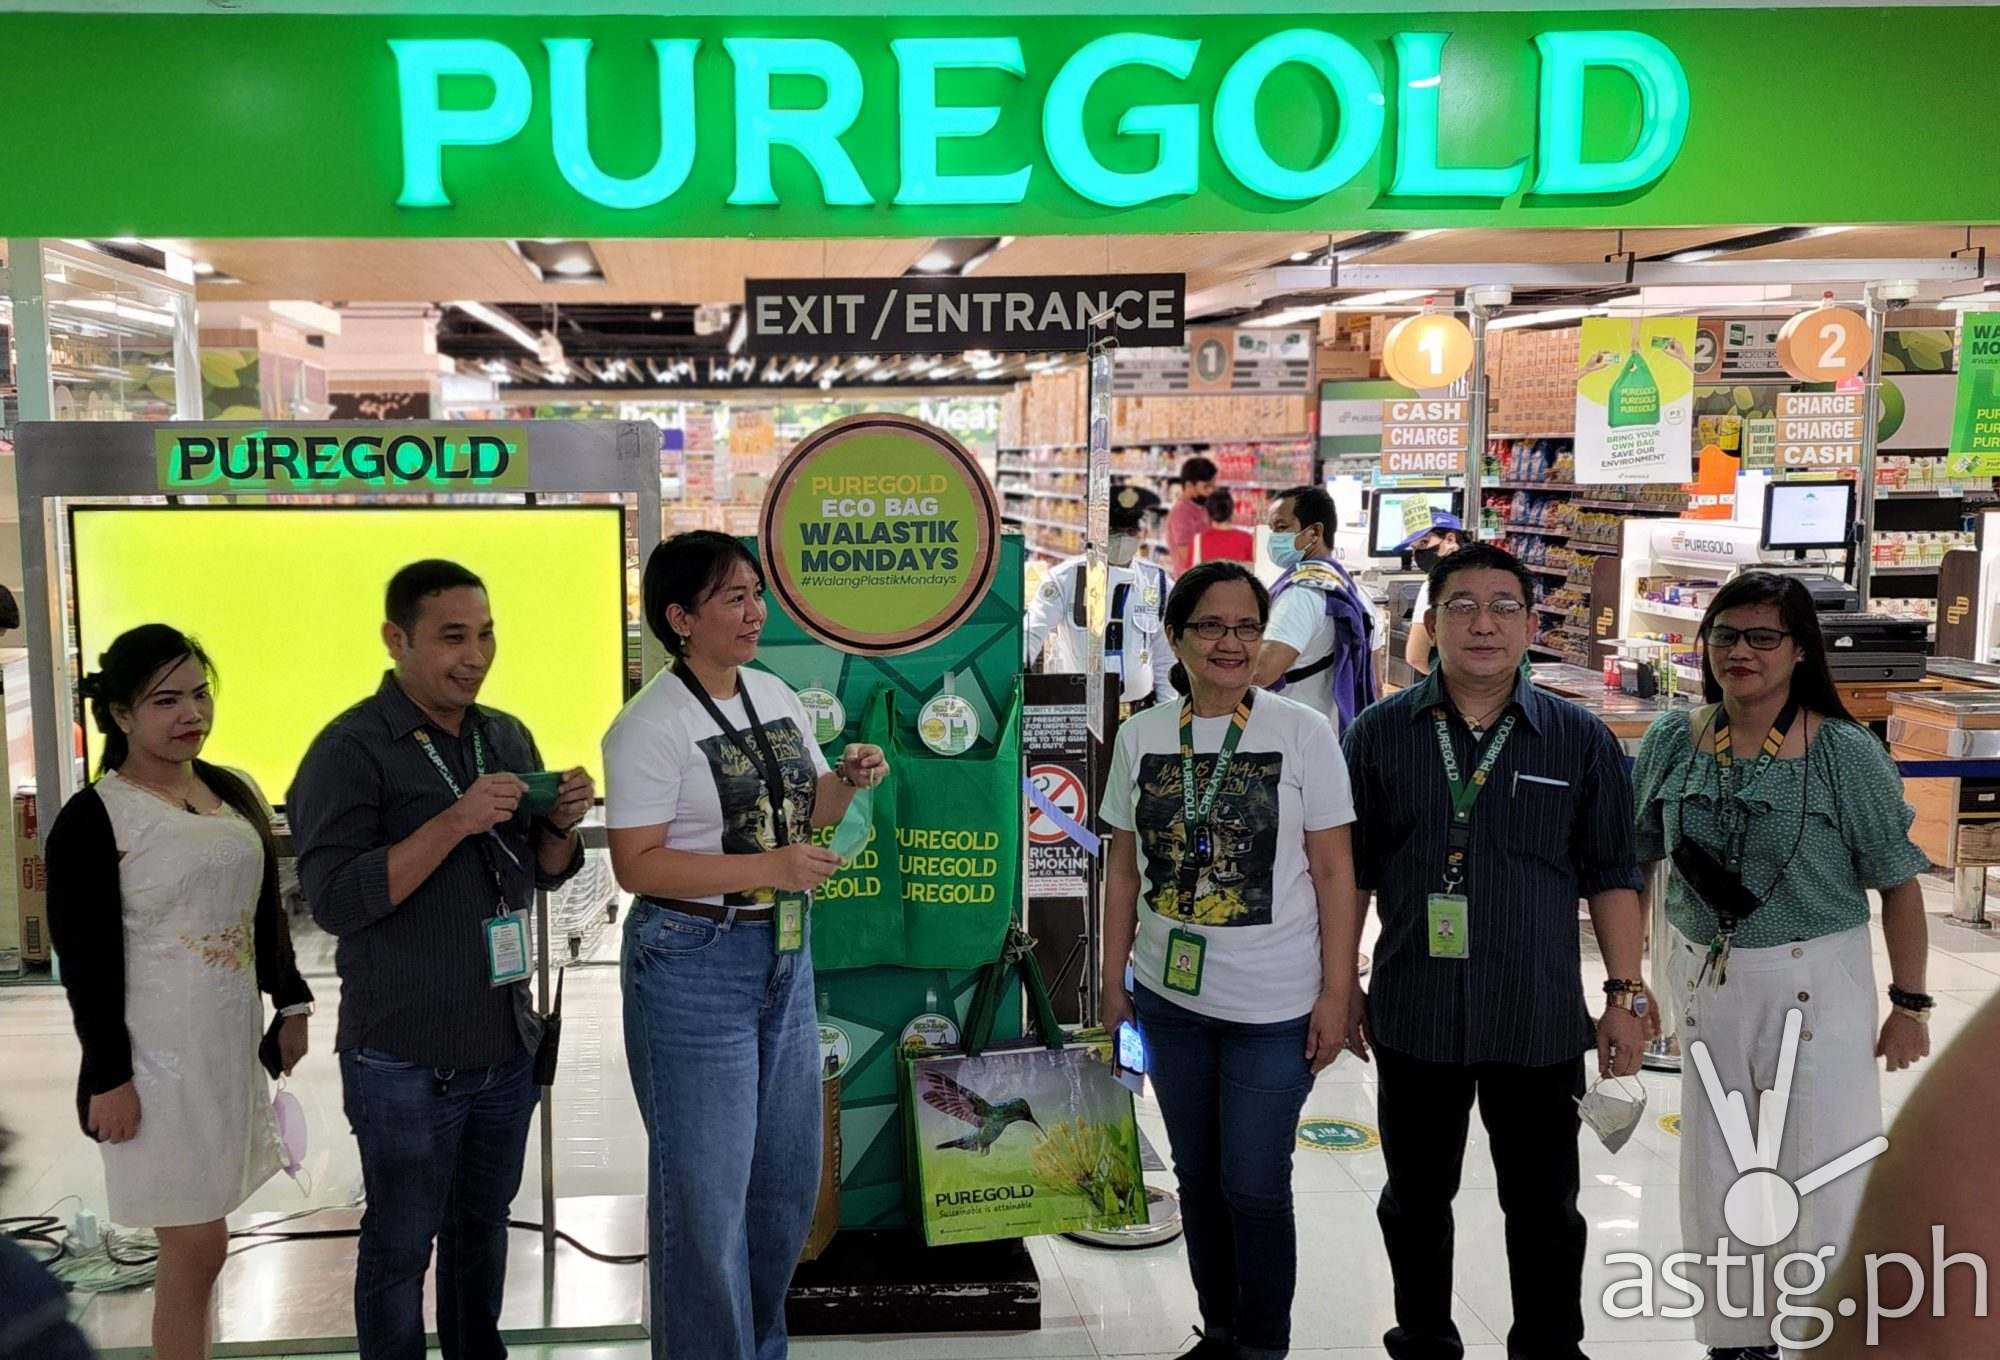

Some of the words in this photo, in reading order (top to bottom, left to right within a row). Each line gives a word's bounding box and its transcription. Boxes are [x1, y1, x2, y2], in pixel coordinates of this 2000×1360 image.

[387, 29, 1691, 209] PUREGOLD
[755, 295, 865, 335] EXIT
[905, 289, 1176, 334] ENTRANCE
[1417, 328, 1444, 375] 1
[1818, 323, 1847, 368] 2
[1203, 347, 1218, 373] 1
[920, 402, 997, 429] Meat
[1391, 402, 1461, 421] CASH
[1786, 396, 1855, 415] CHARGE
[1391, 427, 1459, 446] CHARGE
[1606, 435, 1634, 443] BRING
[1637, 430, 1660, 438] YOUR
[1786, 421, 1855, 440] CHARGE
[1611, 450, 1634, 459] SAVE
[1636, 447, 1655, 455] OUR
[1636, 439, 1655, 447] BAG
[177, 435, 509, 481] PUREGOLD
[1389, 452, 1458, 471] CHARGE
[1601, 454, 1665, 467] ENVIRONMENT
[1784, 446, 1853, 464] CASH
[811, 475, 948, 496] PUREGOLD
[822, 500, 875, 518] ECO
[885, 498, 939, 516] BAG
[799, 520, 960, 545] WALASTIK
[1684, 538, 1734, 555] PUREGOLD
[801, 548, 960, 573] MONDAYS
[801, 573, 958, 589] #WalangPlastikMondays
[1436, 721, 1458, 781] PUREGOLD
[1482, 715, 1516, 771] PUREGOLD
[1183, 759, 1196, 820] PUREGOLD
[1198, 748, 1232, 816] CREATIVE
[935, 1184, 1034, 1207] PUREGOLD
